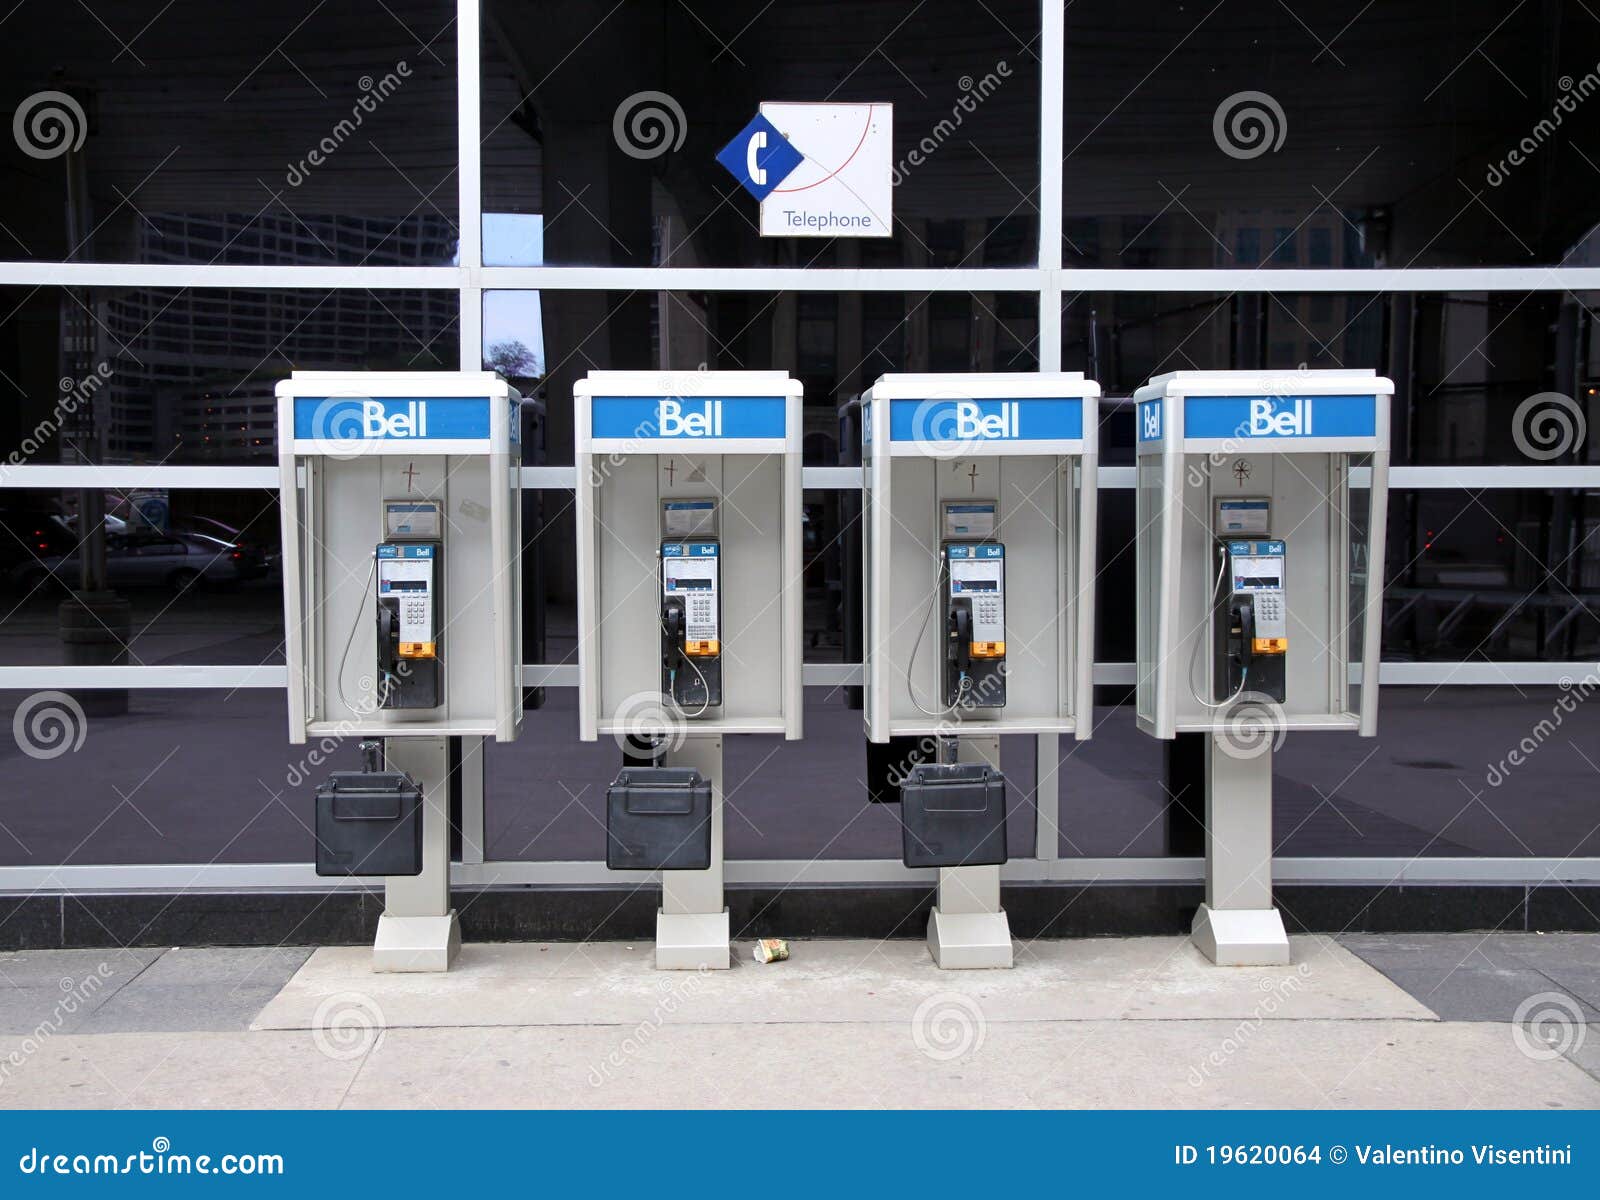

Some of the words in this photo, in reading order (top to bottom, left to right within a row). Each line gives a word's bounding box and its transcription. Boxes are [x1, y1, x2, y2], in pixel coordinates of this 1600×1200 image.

[783, 210, 872, 231] Telephone
[363, 401, 427, 437] Bell
[659, 400, 722, 437] Bell
[957, 402, 1019, 438] Bell
[1144, 403, 1160, 438] Bell
[1250, 399, 1312, 435] Bell
[416, 548, 430, 556] Bell
[987, 548, 1000, 556] Bell
[1268, 545, 1281, 553] Bell
